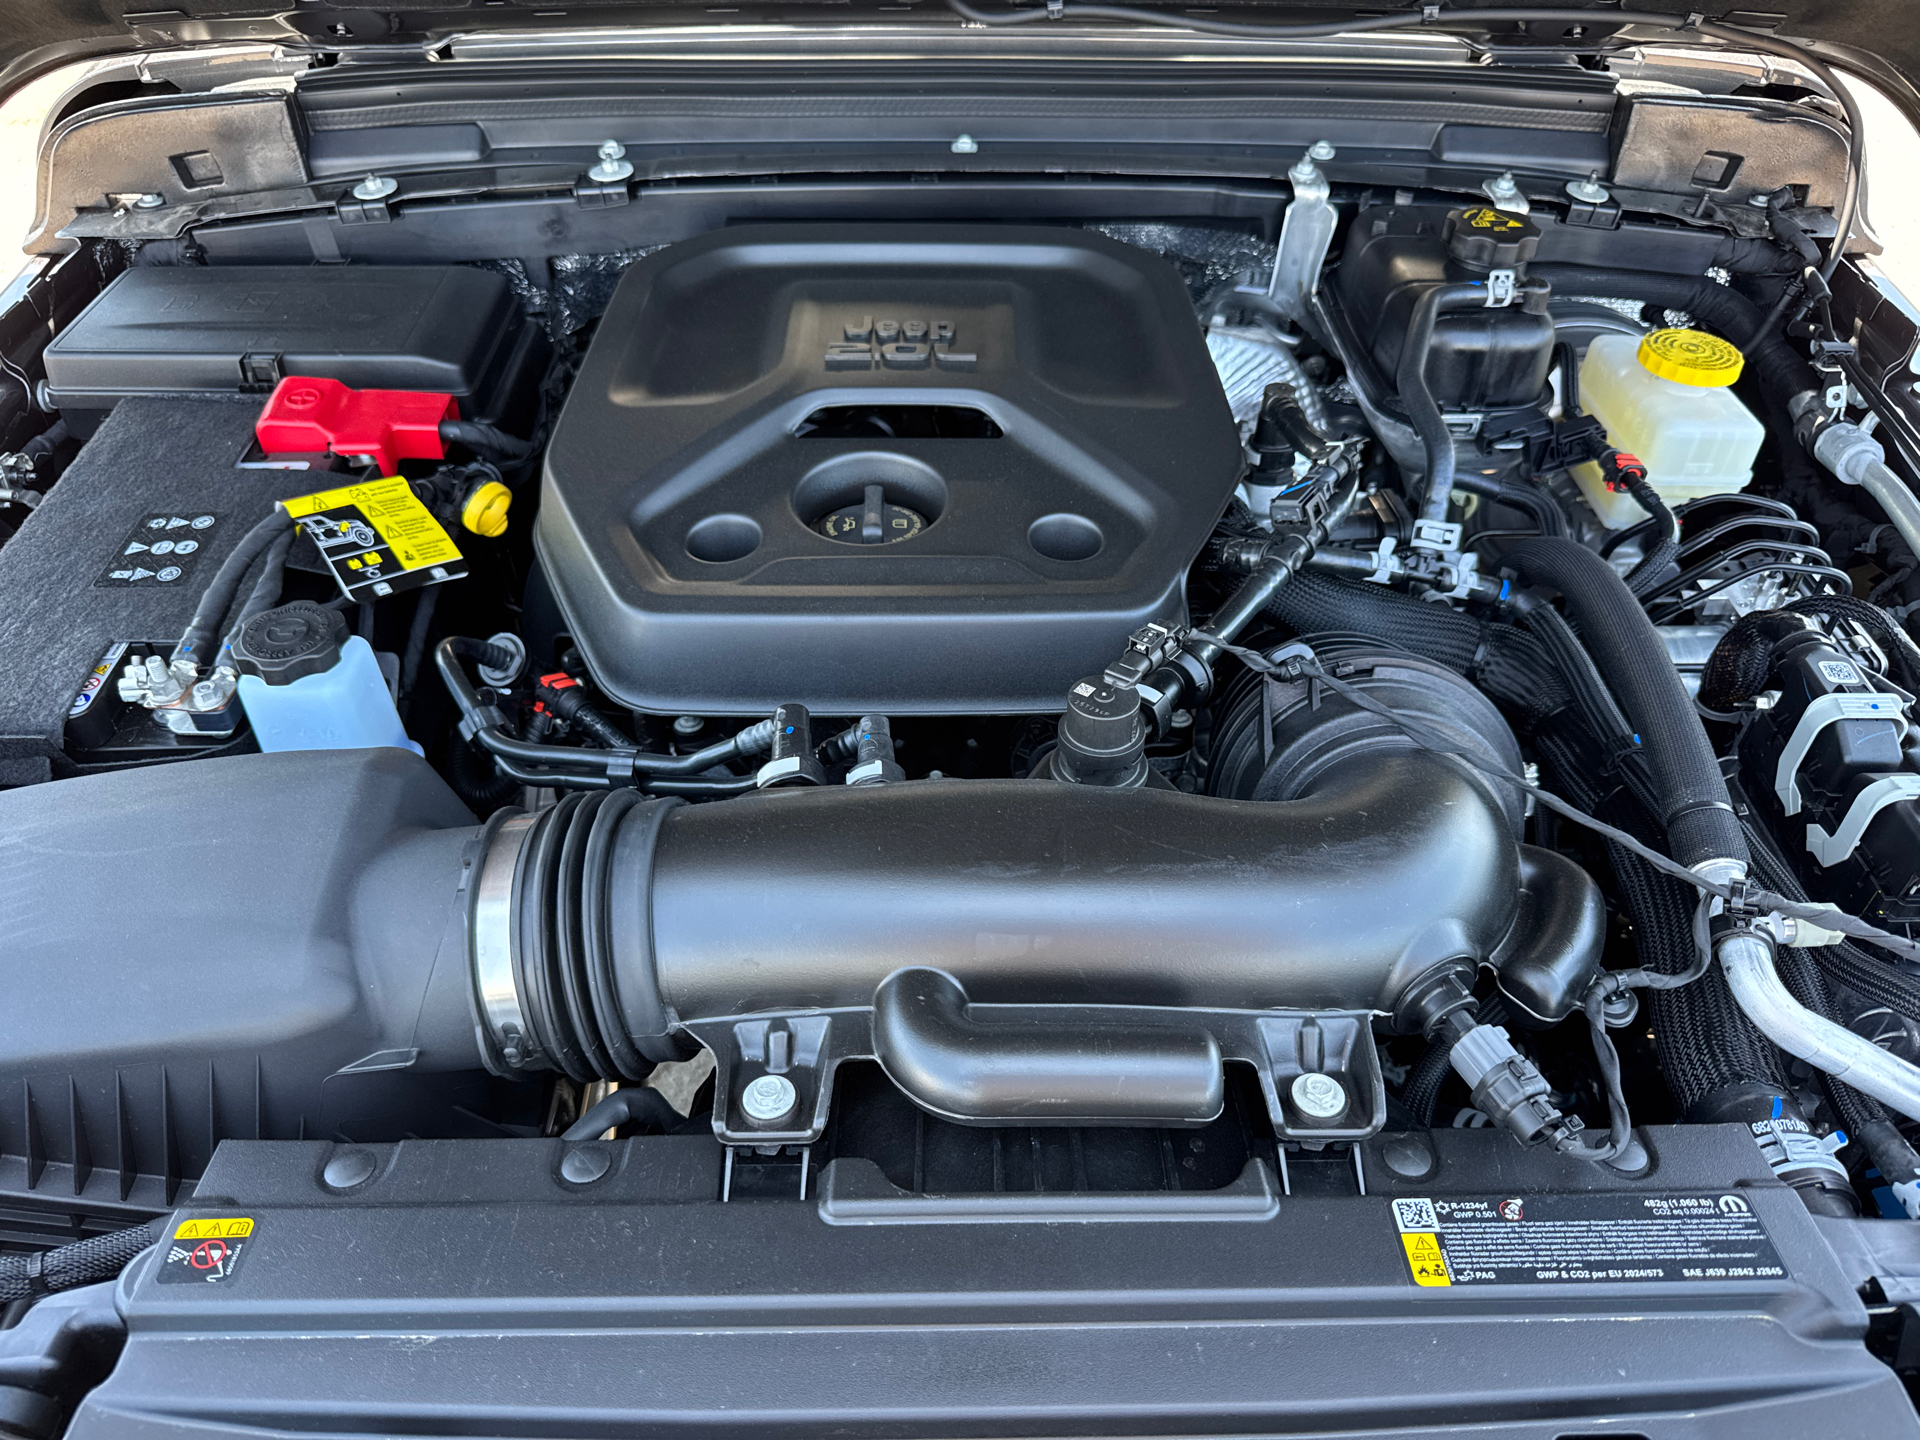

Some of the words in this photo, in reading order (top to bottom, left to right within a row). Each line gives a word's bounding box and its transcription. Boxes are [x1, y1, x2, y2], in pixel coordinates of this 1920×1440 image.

[844, 315, 956, 342] Jeep
[825, 342, 977, 367] 2.0L
[1752, 1119, 1810, 1134] 6820781AD
[1451, 1202, 1488, 1210] R-1234yf
[1644, 1199, 1668, 1208] 482g
[1476, 1271, 1495, 1279] PAG
[1536, 1271, 1558, 1279] GWP
[1560, 1271, 1569, 1279] &
[1570, 1270, 1590, 1279] CO2
[1592, 1270, 1606, 1279] per
[1608, 1269, 1622, 1278] EU
[1624, 1268, 1664, 1278] 2024/573
[1682, 1268, 1703, 1277] SAE
